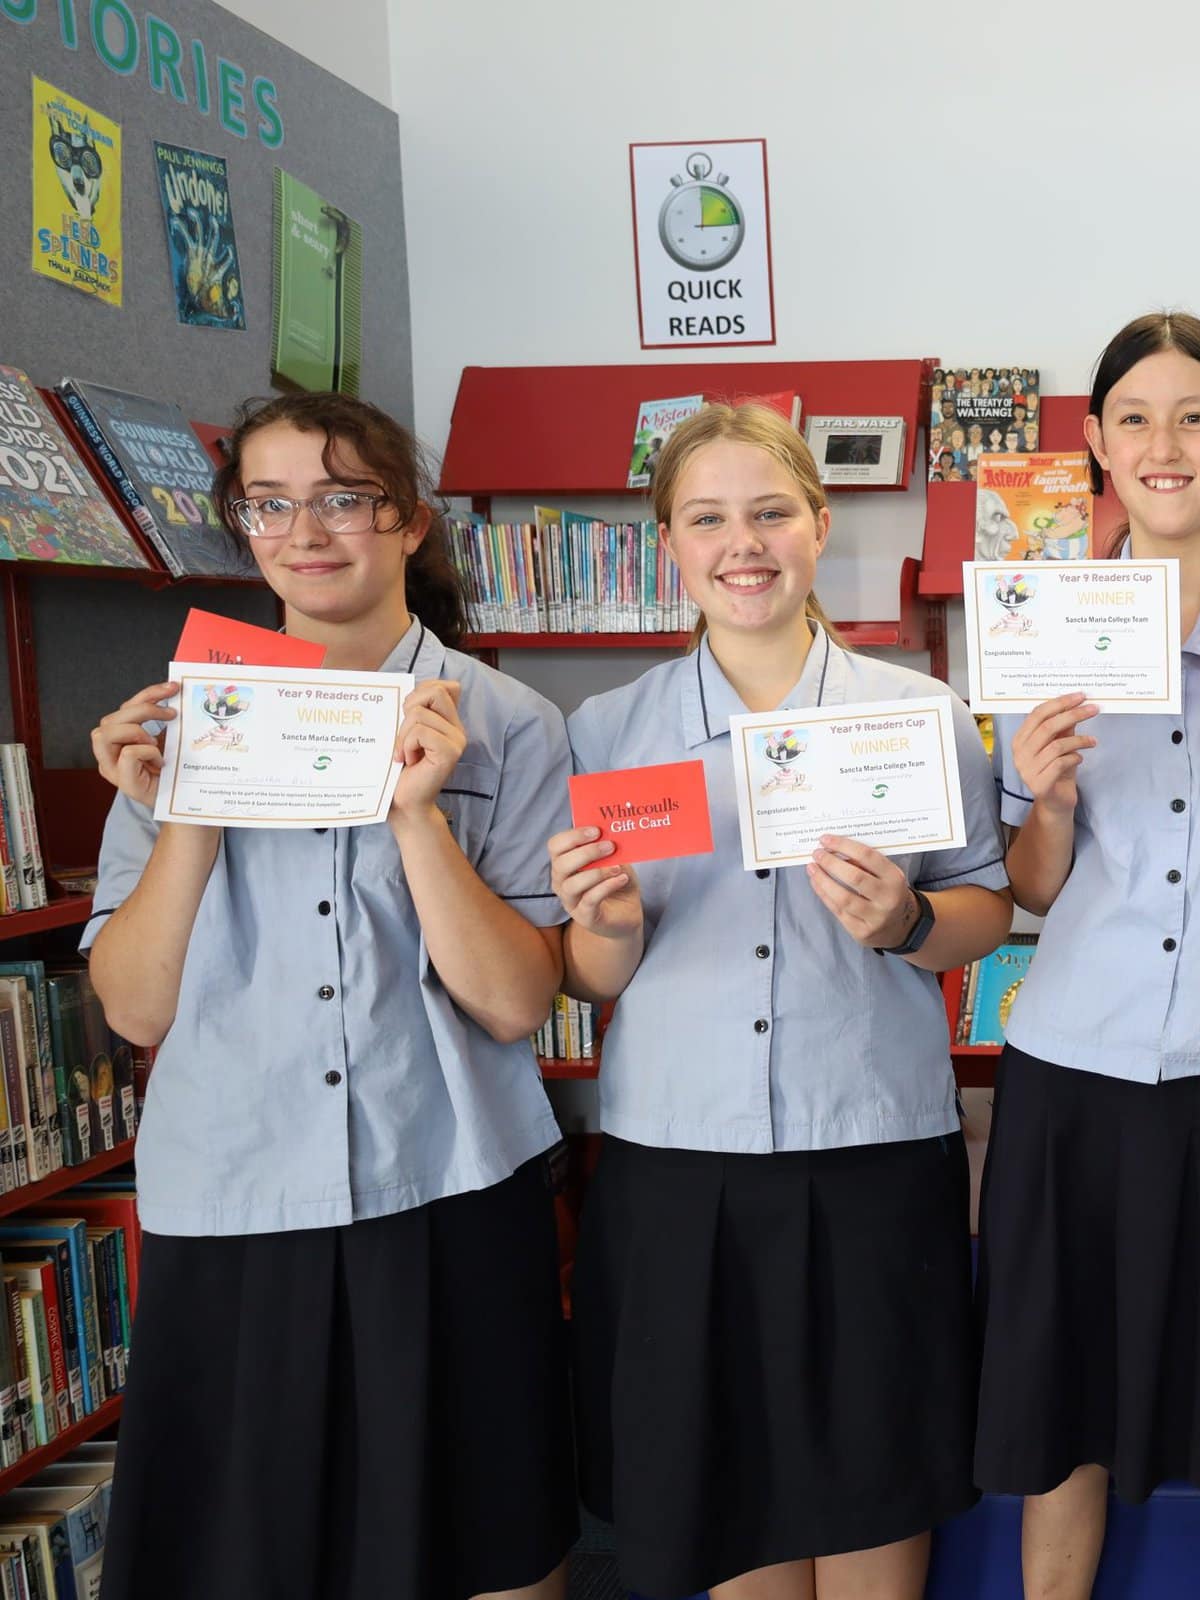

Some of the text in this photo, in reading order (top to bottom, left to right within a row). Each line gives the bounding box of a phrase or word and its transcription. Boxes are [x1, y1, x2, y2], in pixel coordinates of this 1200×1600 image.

[156, 146, 180, 164] PAUL
[667, 279, 744, 303] QUICK
[668, 315, 746, 337] READS
[956, 398, 1014, 407] THE TREATY OF
[956, 407, 1014, 418] WAITANGI
[814, 419, 898, 429] STAR WARS
[110, 420, 197, 450] GUINNESS
[117, 437, 210, 473] WORLD
[135, 464, 214, 492] RECORD
[983, 468, 1036, 488] Asterix
[1058, 572, 1153, 583] Year 9 Readers Cup
[1077, 591, 1136, 607] WINNER
[1107, 616, 1131, 625] College
[277, 688, 384, 704] Year 9 Readers Cup
[297, 708, 363, 726] WINNER
[829, 718, 926, 735] Year 9 Readers Cup
[281, 733, 376, 745] Sancta Maria College Team
[850, 736, 911, 756] WINNER
[839, 759, 926, 774] Sancta Maria College Team
[600, 797, 680, 820] Whitcoulls
[611, 814, 672, 832] Gift Card
